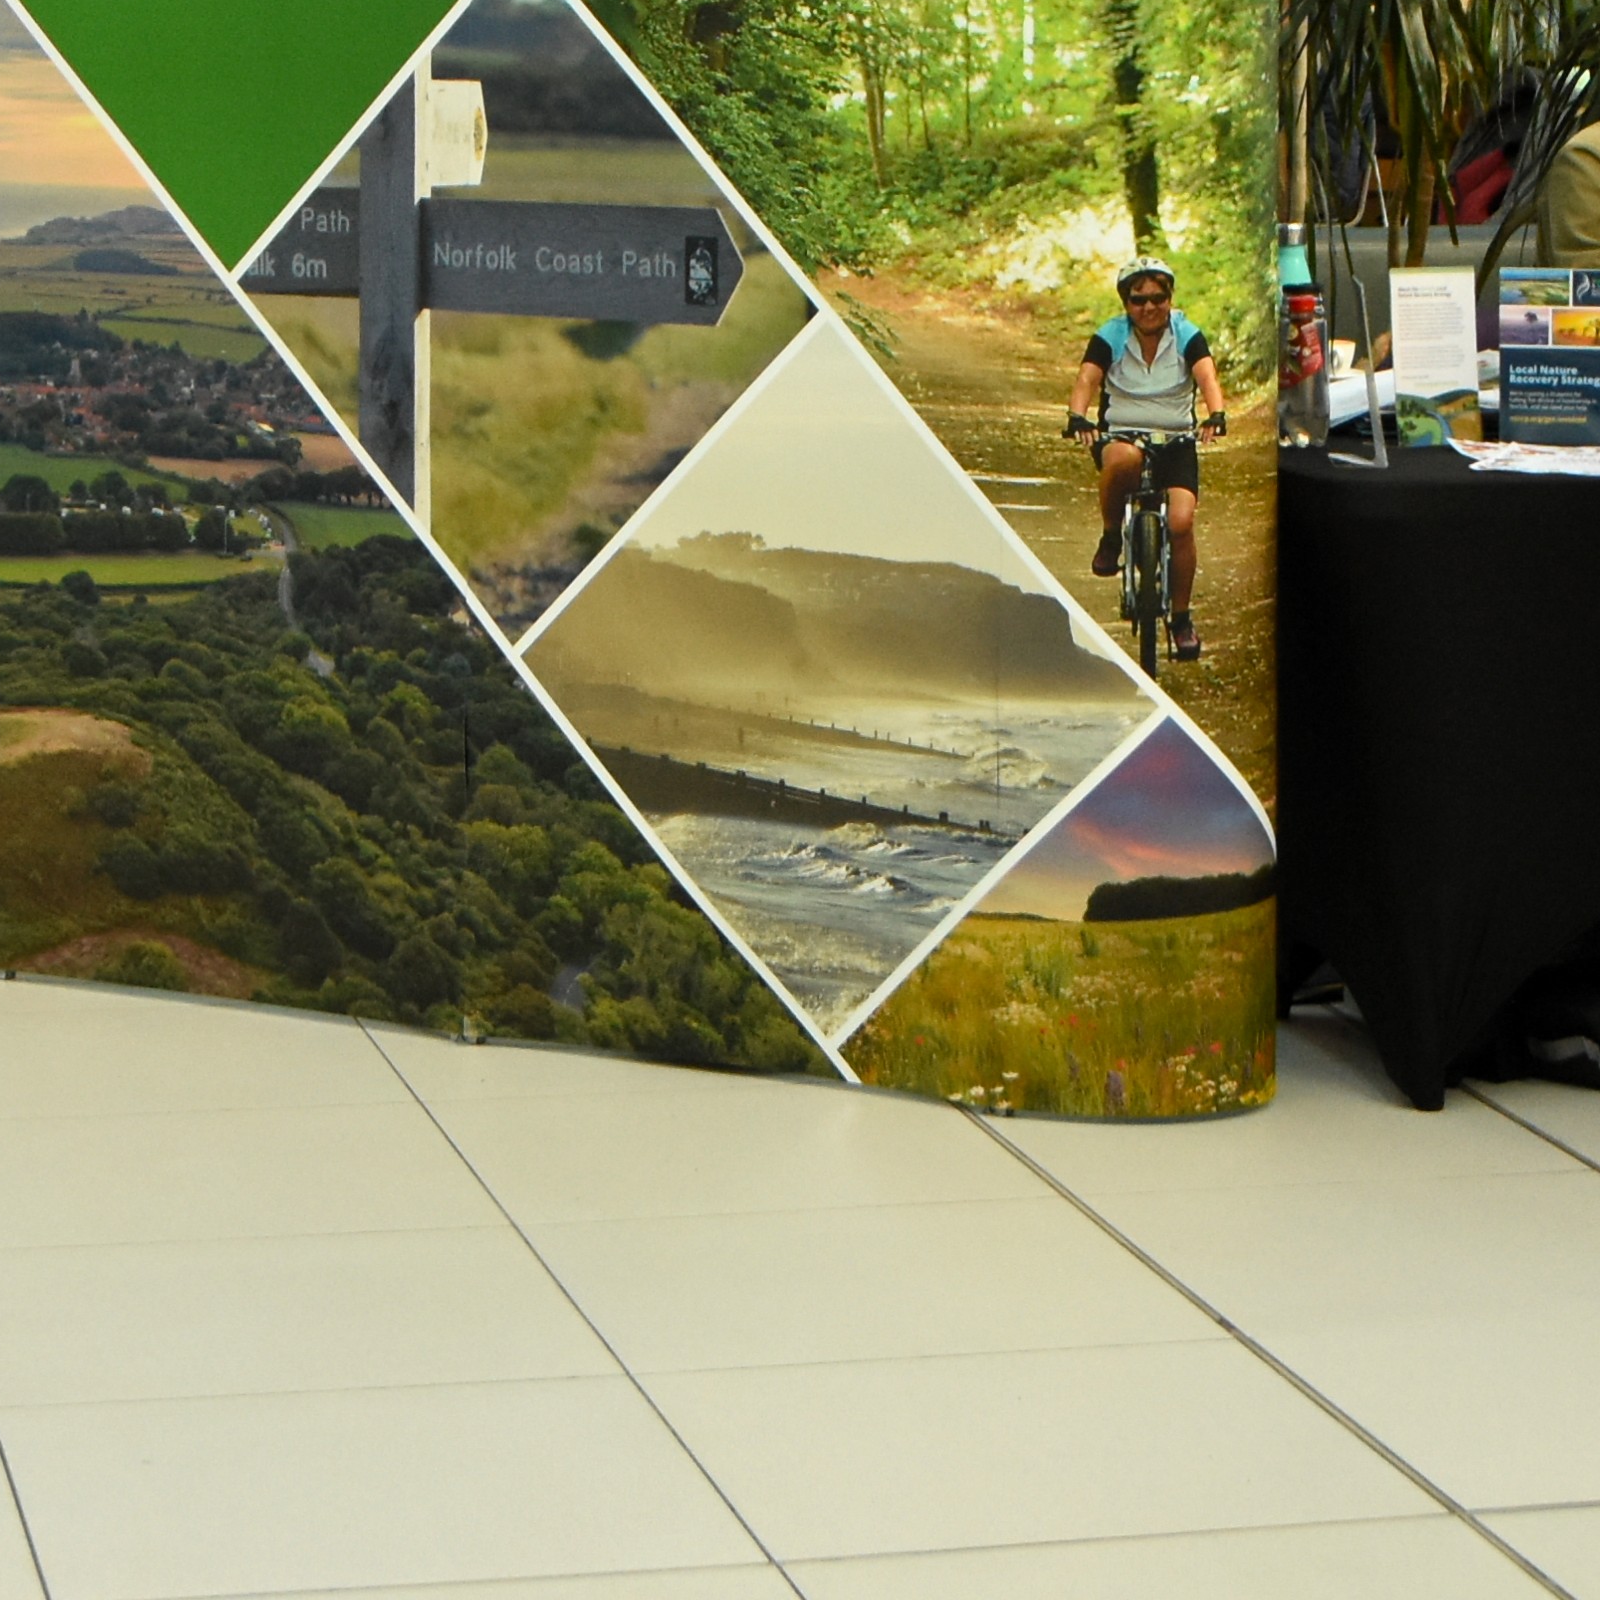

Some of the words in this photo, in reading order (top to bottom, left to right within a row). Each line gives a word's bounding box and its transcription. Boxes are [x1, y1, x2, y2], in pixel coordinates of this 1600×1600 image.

[301, 207, 351, 232] Path
[248, 250, 276, 277] alk
[291, 253, 328, 278] 6m
[432, 242, 516, 271] Norfolk
[535, 247, 604, 277] Coast
[622, 251, 676, 279] Path
[1509, 364, 1537, 375] Local
[1540, 365, 1578, 376] Nature
[1509, 375, 1558, 387] Recovery
